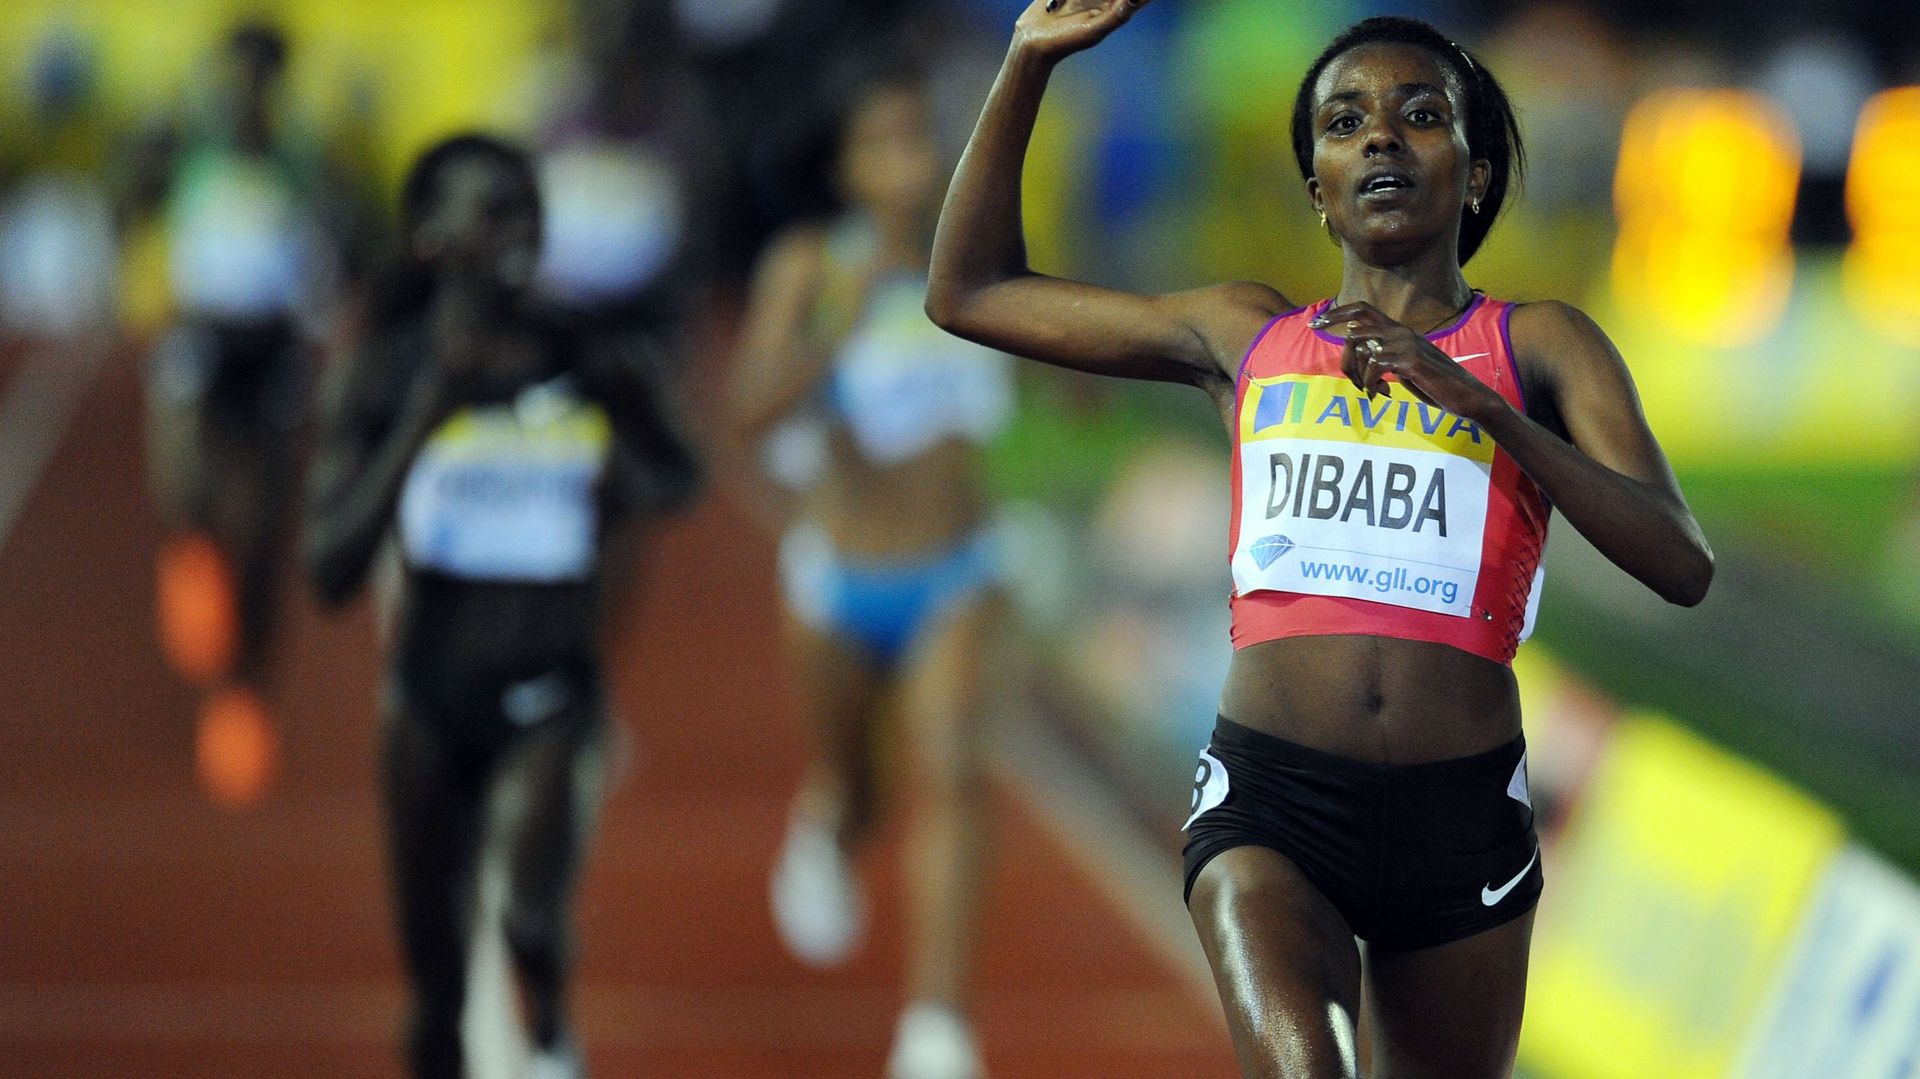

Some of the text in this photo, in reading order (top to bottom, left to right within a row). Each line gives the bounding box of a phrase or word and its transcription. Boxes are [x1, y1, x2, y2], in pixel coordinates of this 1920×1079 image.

[1315, 395, 1481, 444] AVIVA
[1265, 452, 1448, 538] DIBABA
[1300, 560, 1458, 604] www.gll.org
